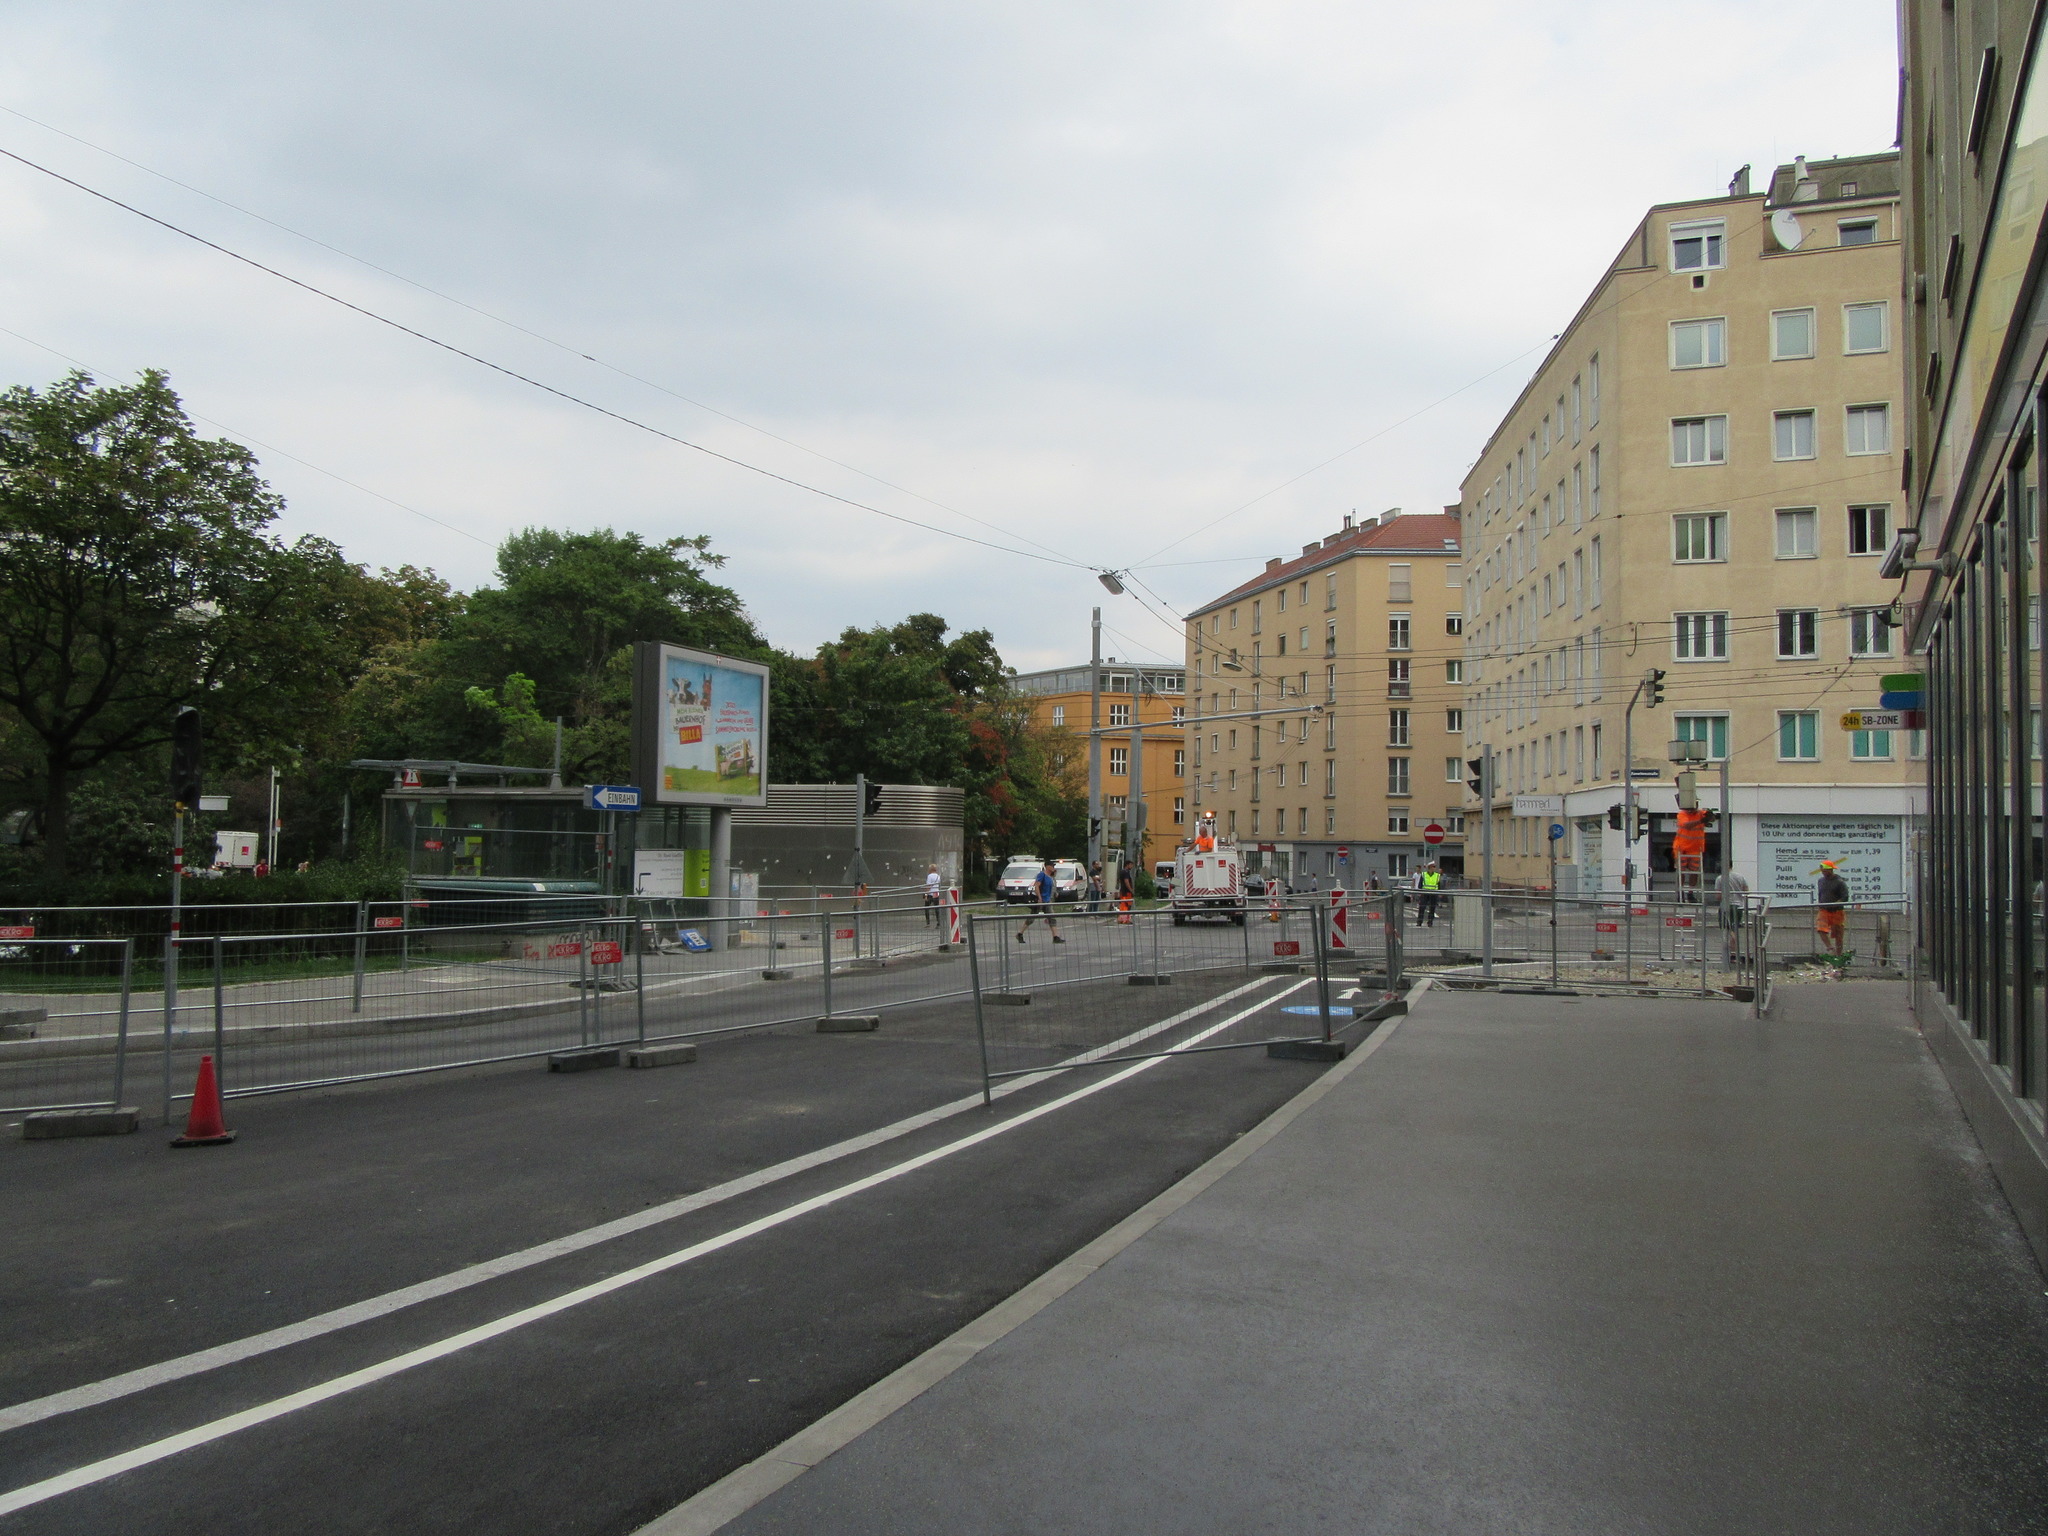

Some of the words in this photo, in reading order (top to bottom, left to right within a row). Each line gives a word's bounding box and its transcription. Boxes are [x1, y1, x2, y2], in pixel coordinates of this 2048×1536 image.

[1843, 717, 1859, 725] 24h
[1862, 716, 1899, 725] SB-ZONE
[680, 728, 701, 741] BILLA
[607, 793, 636, 804] EINBAHN
[1857, 823, 1881, 831] täglich
[1848, 831, 1886, 839] ganztägig!
[593, 952, 611, 962] EKRO
